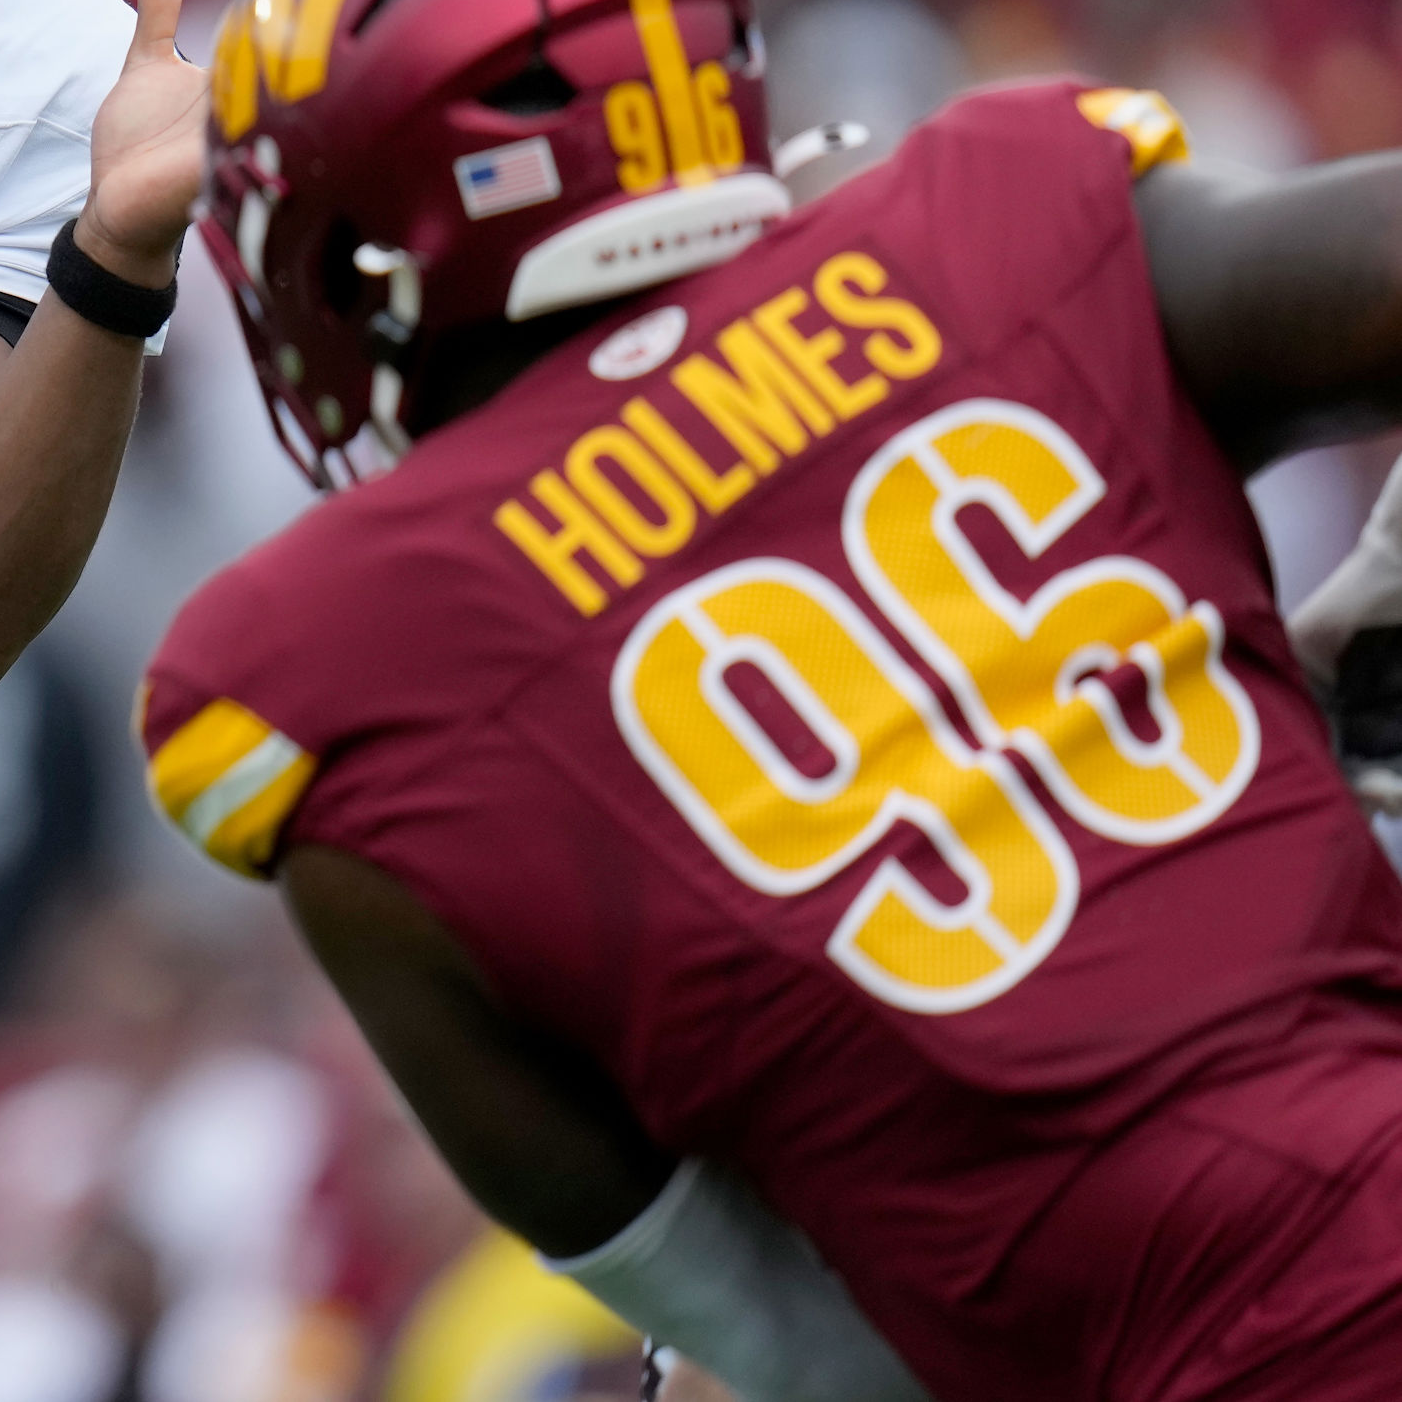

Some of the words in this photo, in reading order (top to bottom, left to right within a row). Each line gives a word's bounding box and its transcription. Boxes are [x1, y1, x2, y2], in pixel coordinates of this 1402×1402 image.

[604, 59, 745, 197] 96
[491, 250, 943, 618] HOLMES
[609, 397, 1261, 1015] 96
